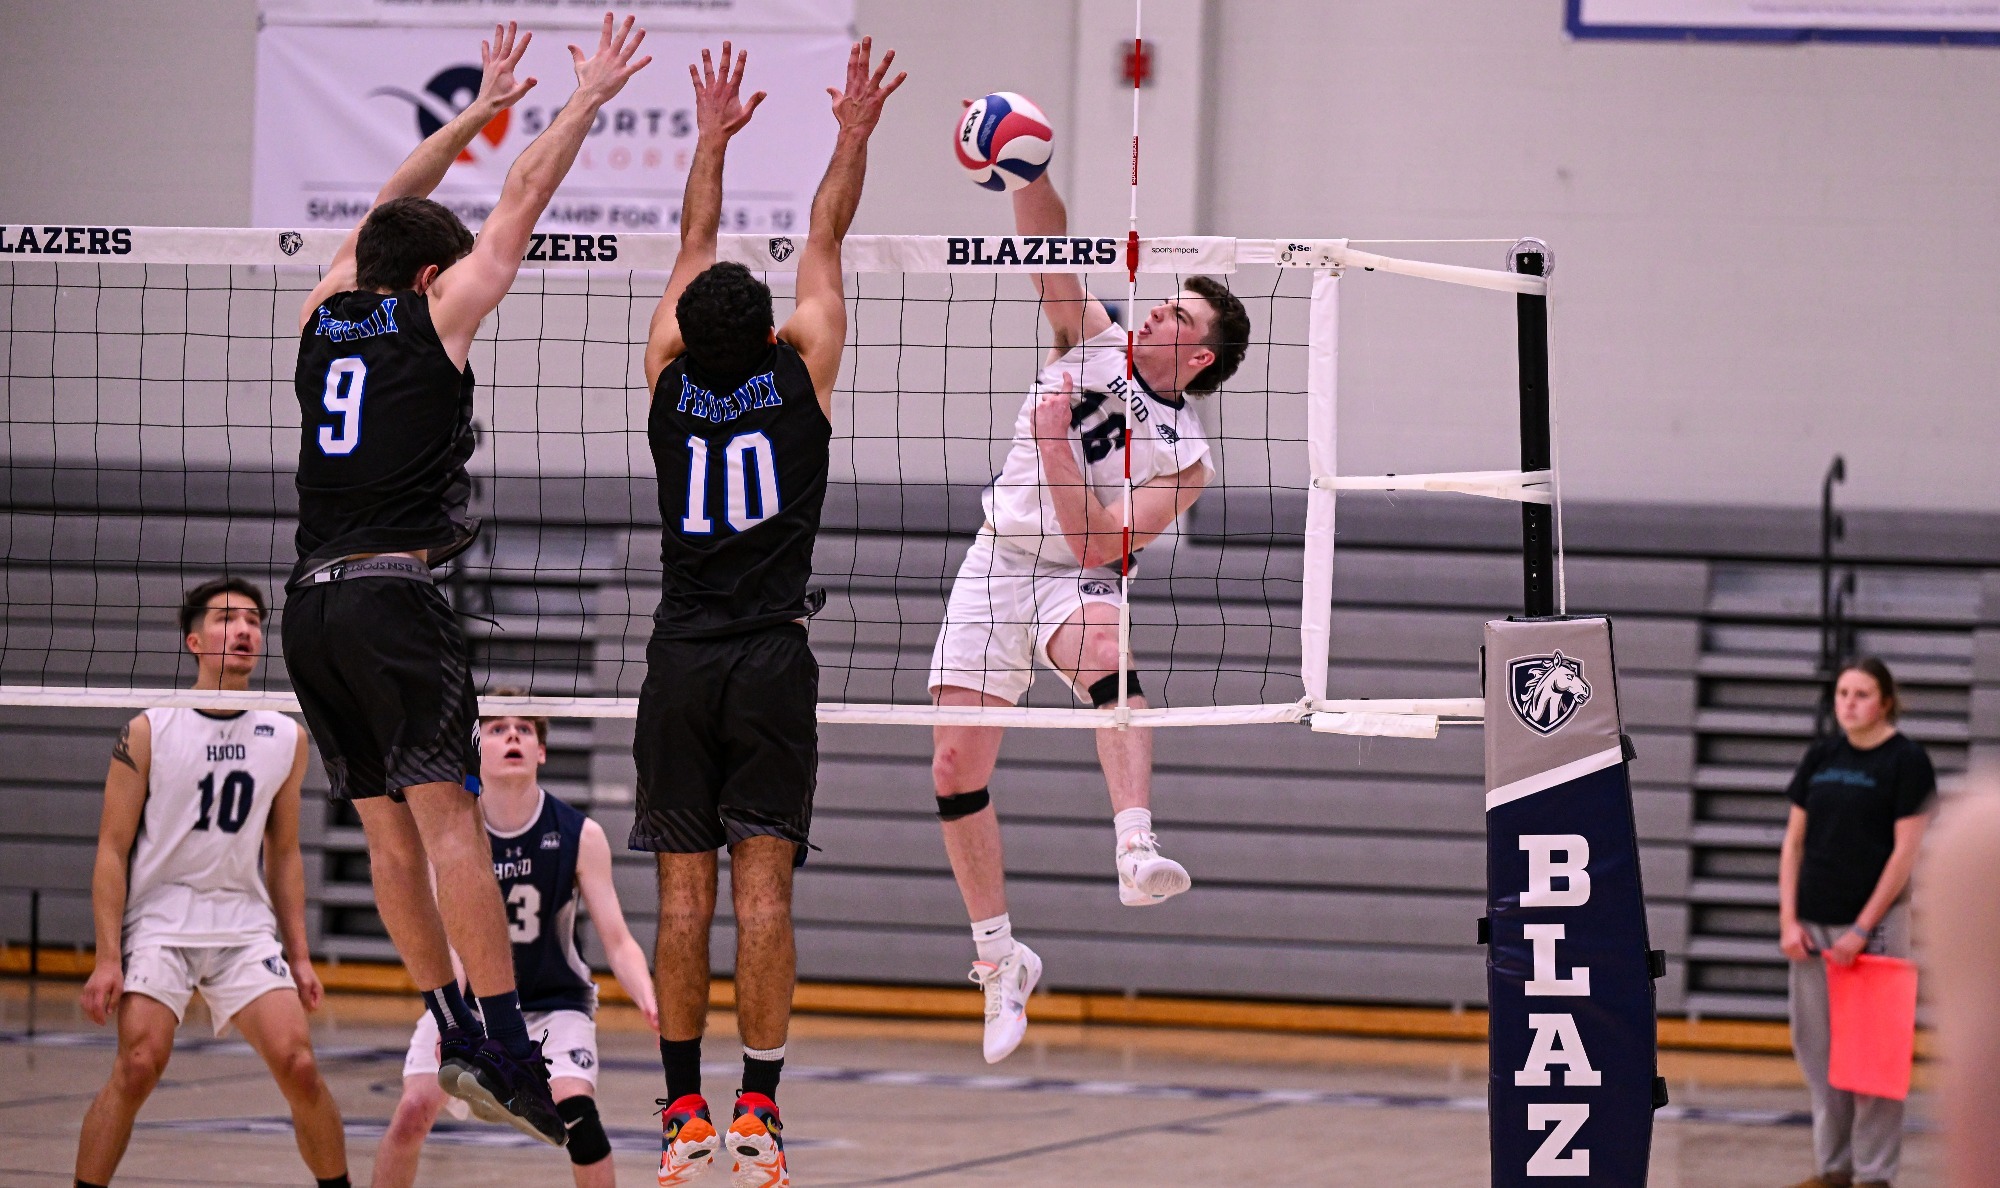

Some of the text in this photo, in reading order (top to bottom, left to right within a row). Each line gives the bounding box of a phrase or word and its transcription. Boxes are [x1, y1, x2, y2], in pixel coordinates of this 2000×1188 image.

[522, 106, 692, 138] SORTS
[0, 227, 131, 254] LAZERS
[524, 234, 617, 261] ZERS
[947, 237, 1116, 265] BLAZERS
[317, 354, 368, 457] 9
[677, 371, 783, 423] PHOENIX
[681, 429, 782, 535] 10
[192, 770, 255, 834] 10
[1514, 834, 1602, 1177] BLAZ
